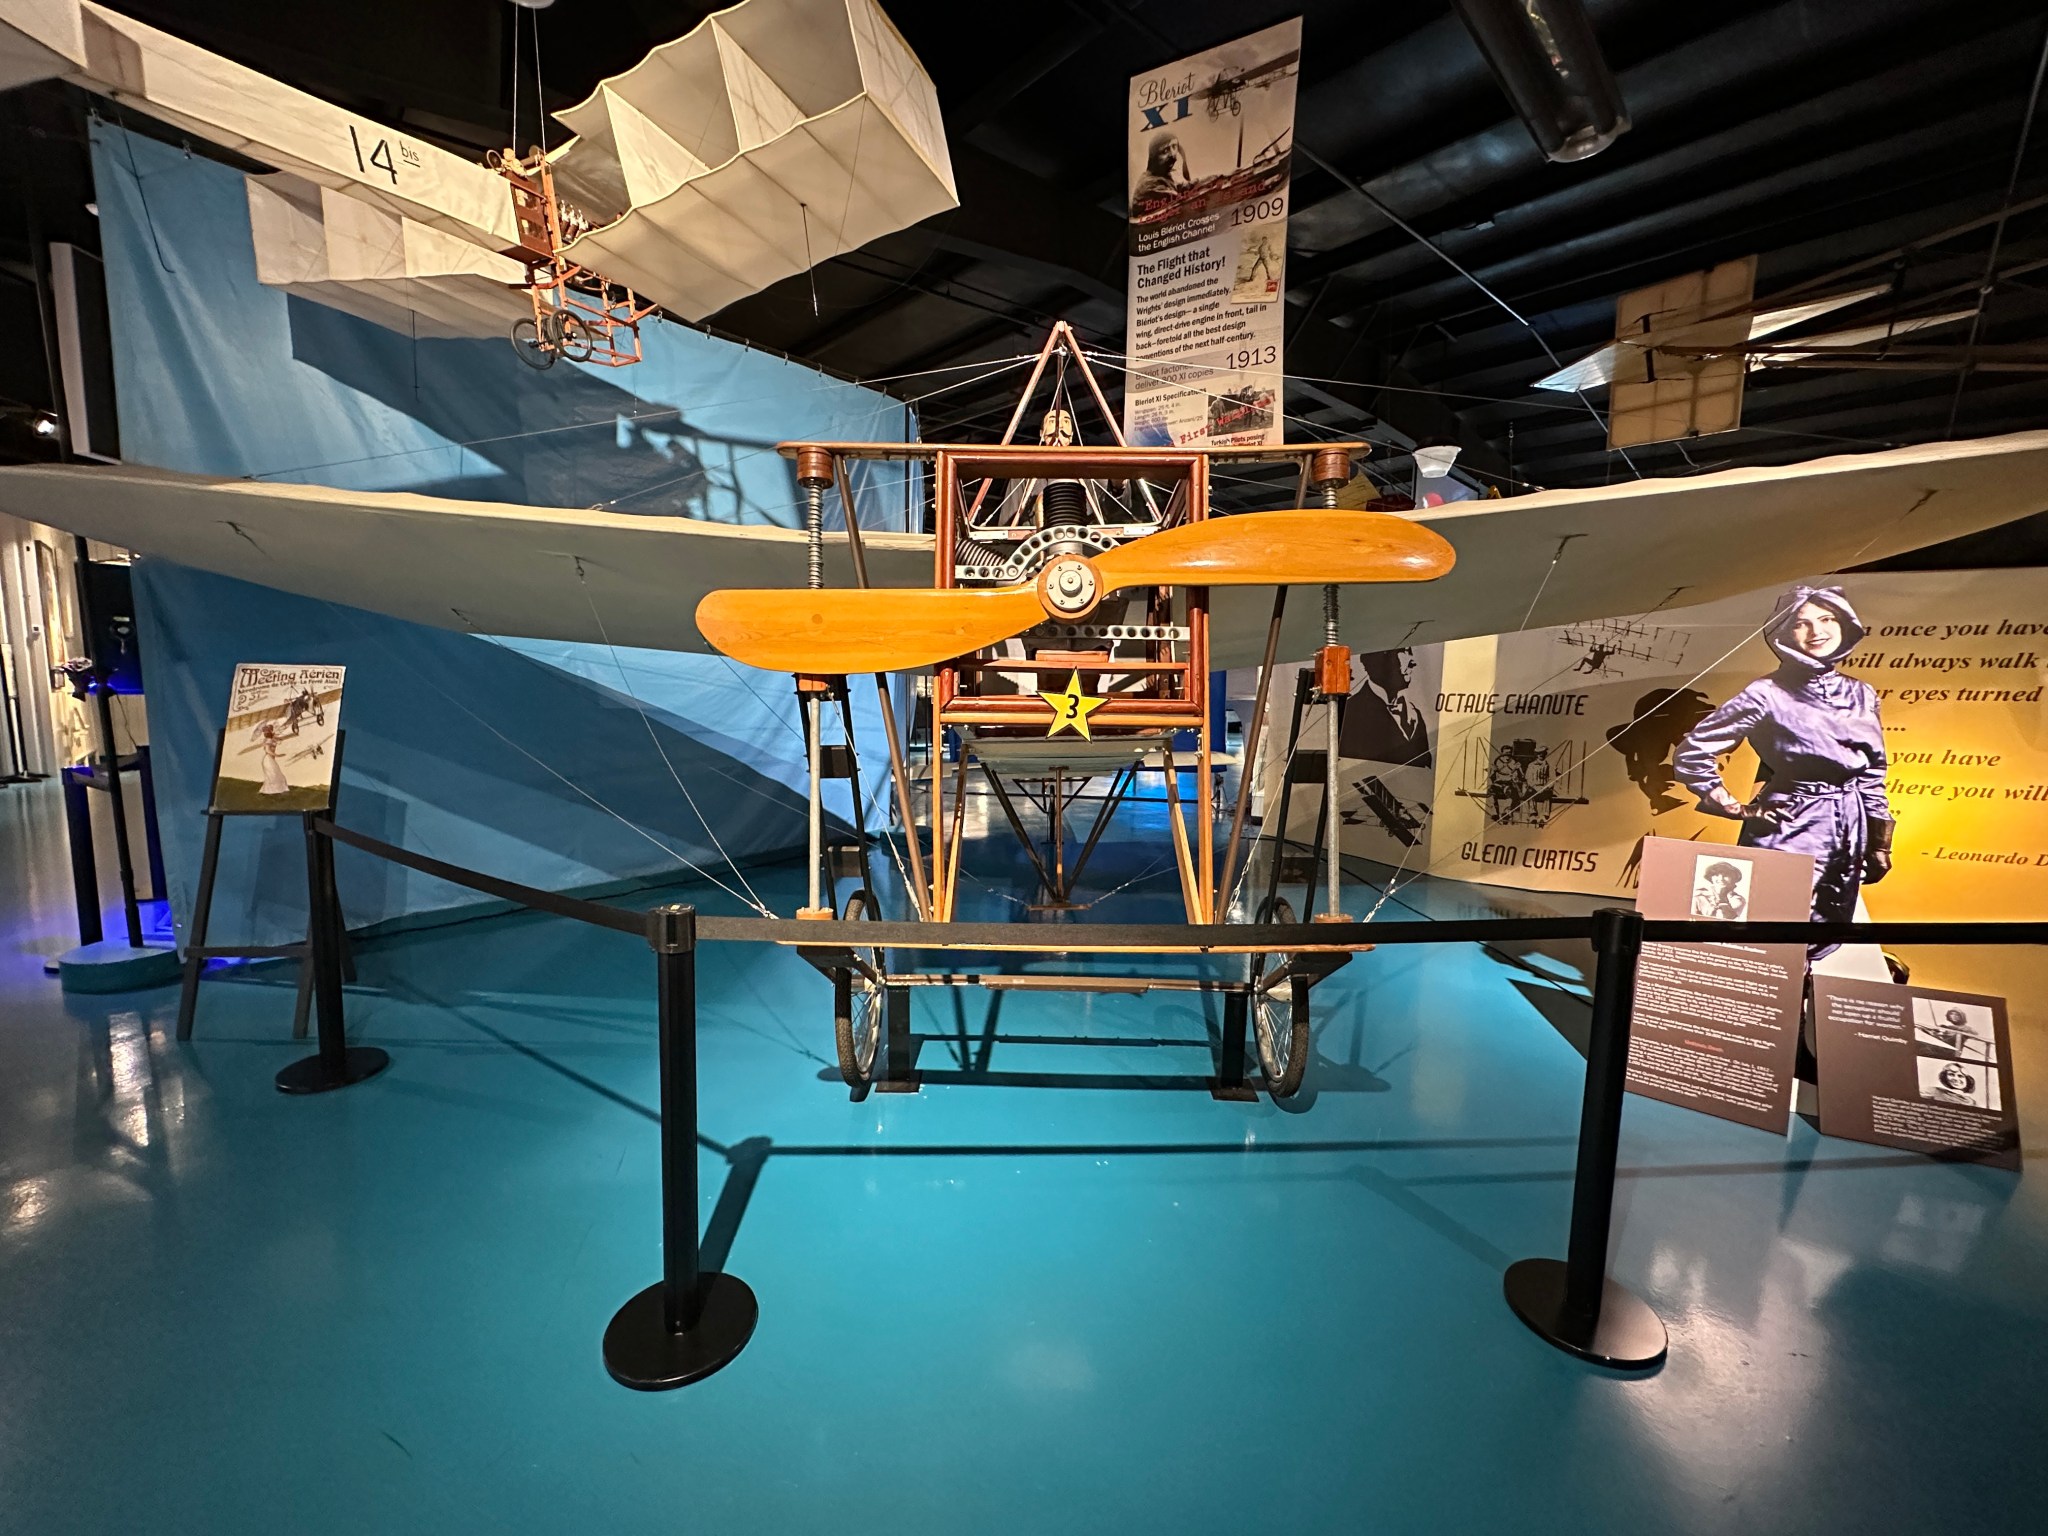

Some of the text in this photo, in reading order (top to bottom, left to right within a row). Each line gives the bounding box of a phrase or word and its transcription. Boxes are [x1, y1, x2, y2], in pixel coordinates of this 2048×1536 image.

[1138, 72, 1195, 108] Bleriot
[1140, 94, 1193, 132] XI
[349, 125, 420, 185] 14 bis
[1230, 197, 1284, 227] 1909
[1138, 229, 1160, 242] Louis
[1187, 213, 1220, 228] Crosses
[1138, 223, 1216, 252] the English Channel
[1137, 246, 1210, 276] The Flight that
[1137, 256, 1226, 288] Changed History!
[1136, 277, 1219, 303] The world abandoned the
[1163, 297, 1186, 310] design
[1187, 286, 1231, 303] immediately.
[1191, 315, 1216, 326] engine
[1216, 312, 1224, 320] in
[1224, 308, 1245, 319] front,
[1245, 305, 1258, 315] tail
[1259, 304, 1267, 312] in
[1198, 301, 1220, 313] single
[1183, 331, 1192, 340] all
[1193, 328, 1204, 337] the
[1205, 324, 1222, 335] best
[1222, 320, 1247, 332] design
[1174, 344, 1182, 353] of
[1183, 342, 1193, 352] the
[1195, 339, 1210, 350] next
[1226, 345, 1276, 370] 1913
[1180, 372, 1187, 380] XI
[1188, 368, 1214, 381] copies
[1180, 424, 1212, 444] First
[1880, 625, 1937, 637] once
[1940, 624, 1990, 640] you
[1841, 652, 2040, 672] will always walk
[1435, 693, 1589, 716] OCTAVE CHANUTE
[1900, 689, 1950, 704] eyes
[1956, 685, 2045, 702] turned
[1066, 694, 1080, 719] 3
[1887, 749, 2001, 767] you have
[1947, 786, 1995, 801] you
[2004, 784, 2048, 801] will
[1461, 841, 1599, 872] GLENN CURTISS
[1934, 847, 2029, 866] Leonardo
